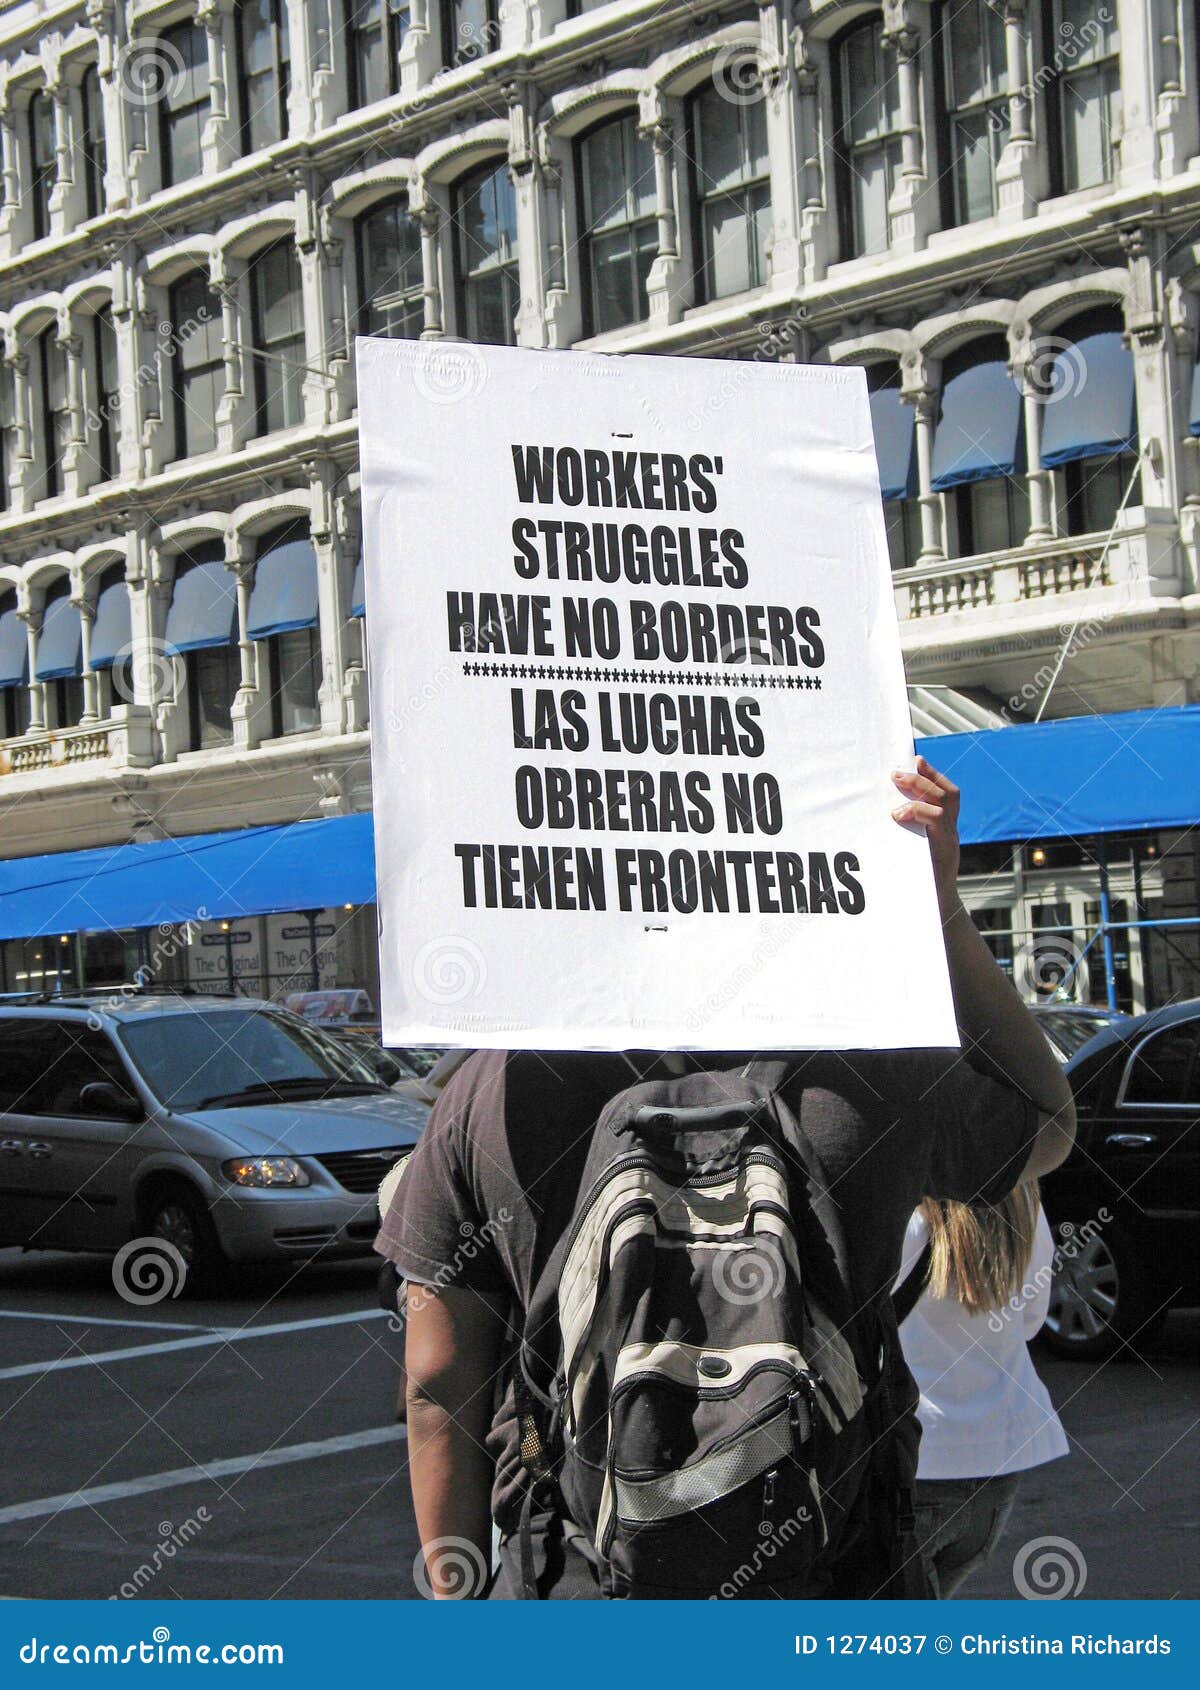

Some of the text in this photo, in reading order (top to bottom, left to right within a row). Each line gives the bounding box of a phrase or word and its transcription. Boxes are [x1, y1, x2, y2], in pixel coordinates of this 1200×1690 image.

[511, 444, 723, 514] WORKERS'
[511, 517, 748, 589] STRUGGLES
[446, 590, 826, 669] HAVE NO BORDERS
[510, 687, 765, 758] LAS LUCHAS
[515, 764, 783, 836] OBRERAS NO
[454, 843, 866, 916] TIENEN FRONTERAS
[195, 954, 260, 975] The Oginal
[276, 949, 336, 970] The Ogin
